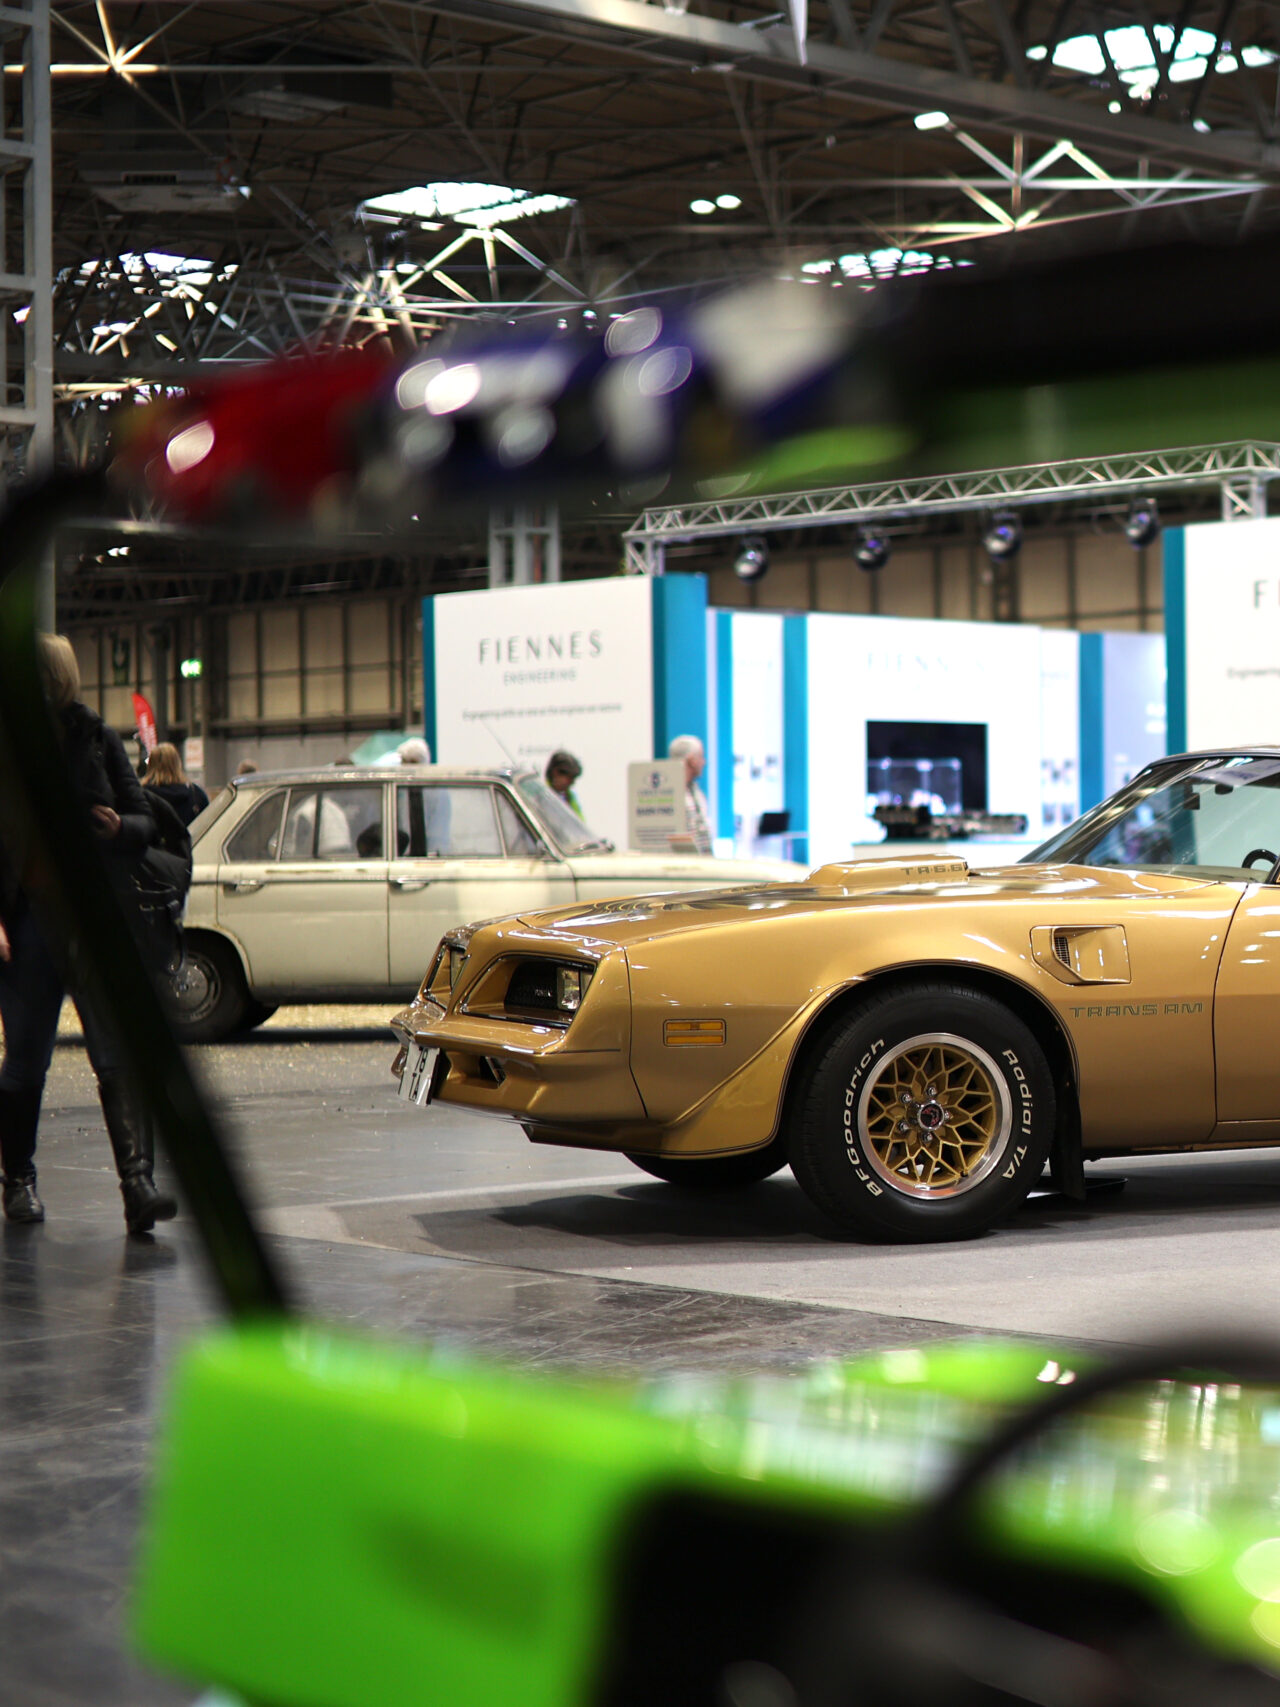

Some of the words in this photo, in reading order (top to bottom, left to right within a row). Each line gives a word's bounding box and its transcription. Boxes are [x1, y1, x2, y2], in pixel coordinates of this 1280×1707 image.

[478, 629, 604, 665] FIENNES
[503, 667, 578, 686] ENGINEERING
[1069, 1003, 1158, 1018] TRANS
[1164, 1002, 1203, 1015] AM
[1002, 1049, 1032, 1135] Radial
[843, 1038, 886, 1197] BFGoodrich
[1001, 1144, 1028, 1179] T/A
